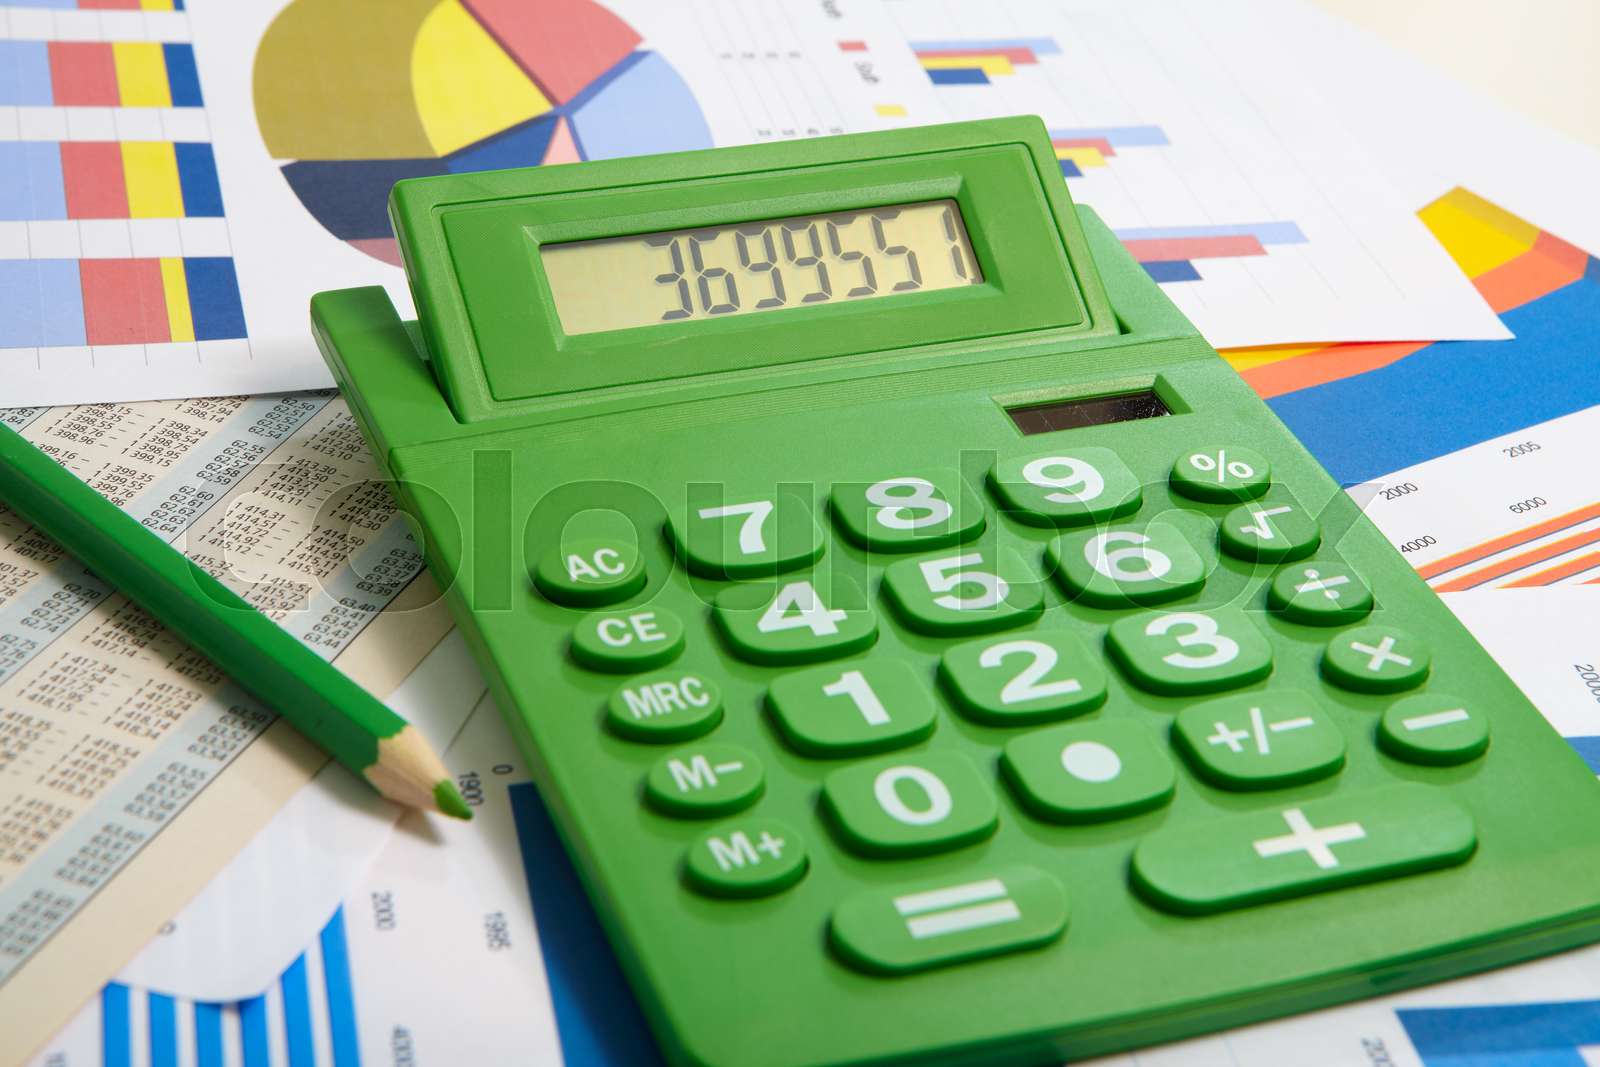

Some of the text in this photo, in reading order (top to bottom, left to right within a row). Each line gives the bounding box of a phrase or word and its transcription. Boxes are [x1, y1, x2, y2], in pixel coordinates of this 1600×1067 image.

[62, 422, 105, 437] 398,76
[139, 443, 181, 459] 398,95
[73, 414, 114, 429] 398,55
[148, 435, 190, 452] 398,75
[82, 407, 124, 422] 398,35
[157, 428, 199, 445] 398,54
[166, 420, 208, 437] 398,34
[53, 429, 96, 445] 398,96
[130, 450, 172, 467] 399,15
[1502, 440, 1542, 459] 2005
[102, 473, 145, 490] 399,55
[111, 465, 155, 482] 399,35
[1022, 456, 1105, 503] 9
[1378, 482, 1419, 501] 2000
[865, 477, 953, 529] 8
[1508, 496, 1548, 515] 6000
[698, 500, 775, 554] 7
[1400, 534, 1438, 554] 4000
[567, 547, 625, 583] AC
[1084, 530, 1171, 582] 6
[919, 552, 1010, 610] 5
[757, 580, 848, 637] 4
[597, 612, 666, 648] CE
[1145, 612, 1240, 668] 3
[979, 640, 1083, 705] 2
[622, 676, 710, 721] MRC
[822, 670, 891, 727] 1
[667, 754, 744, 793] M-
[874, 765, 952, 825] 0
[707, 830, 786, 872] M+
